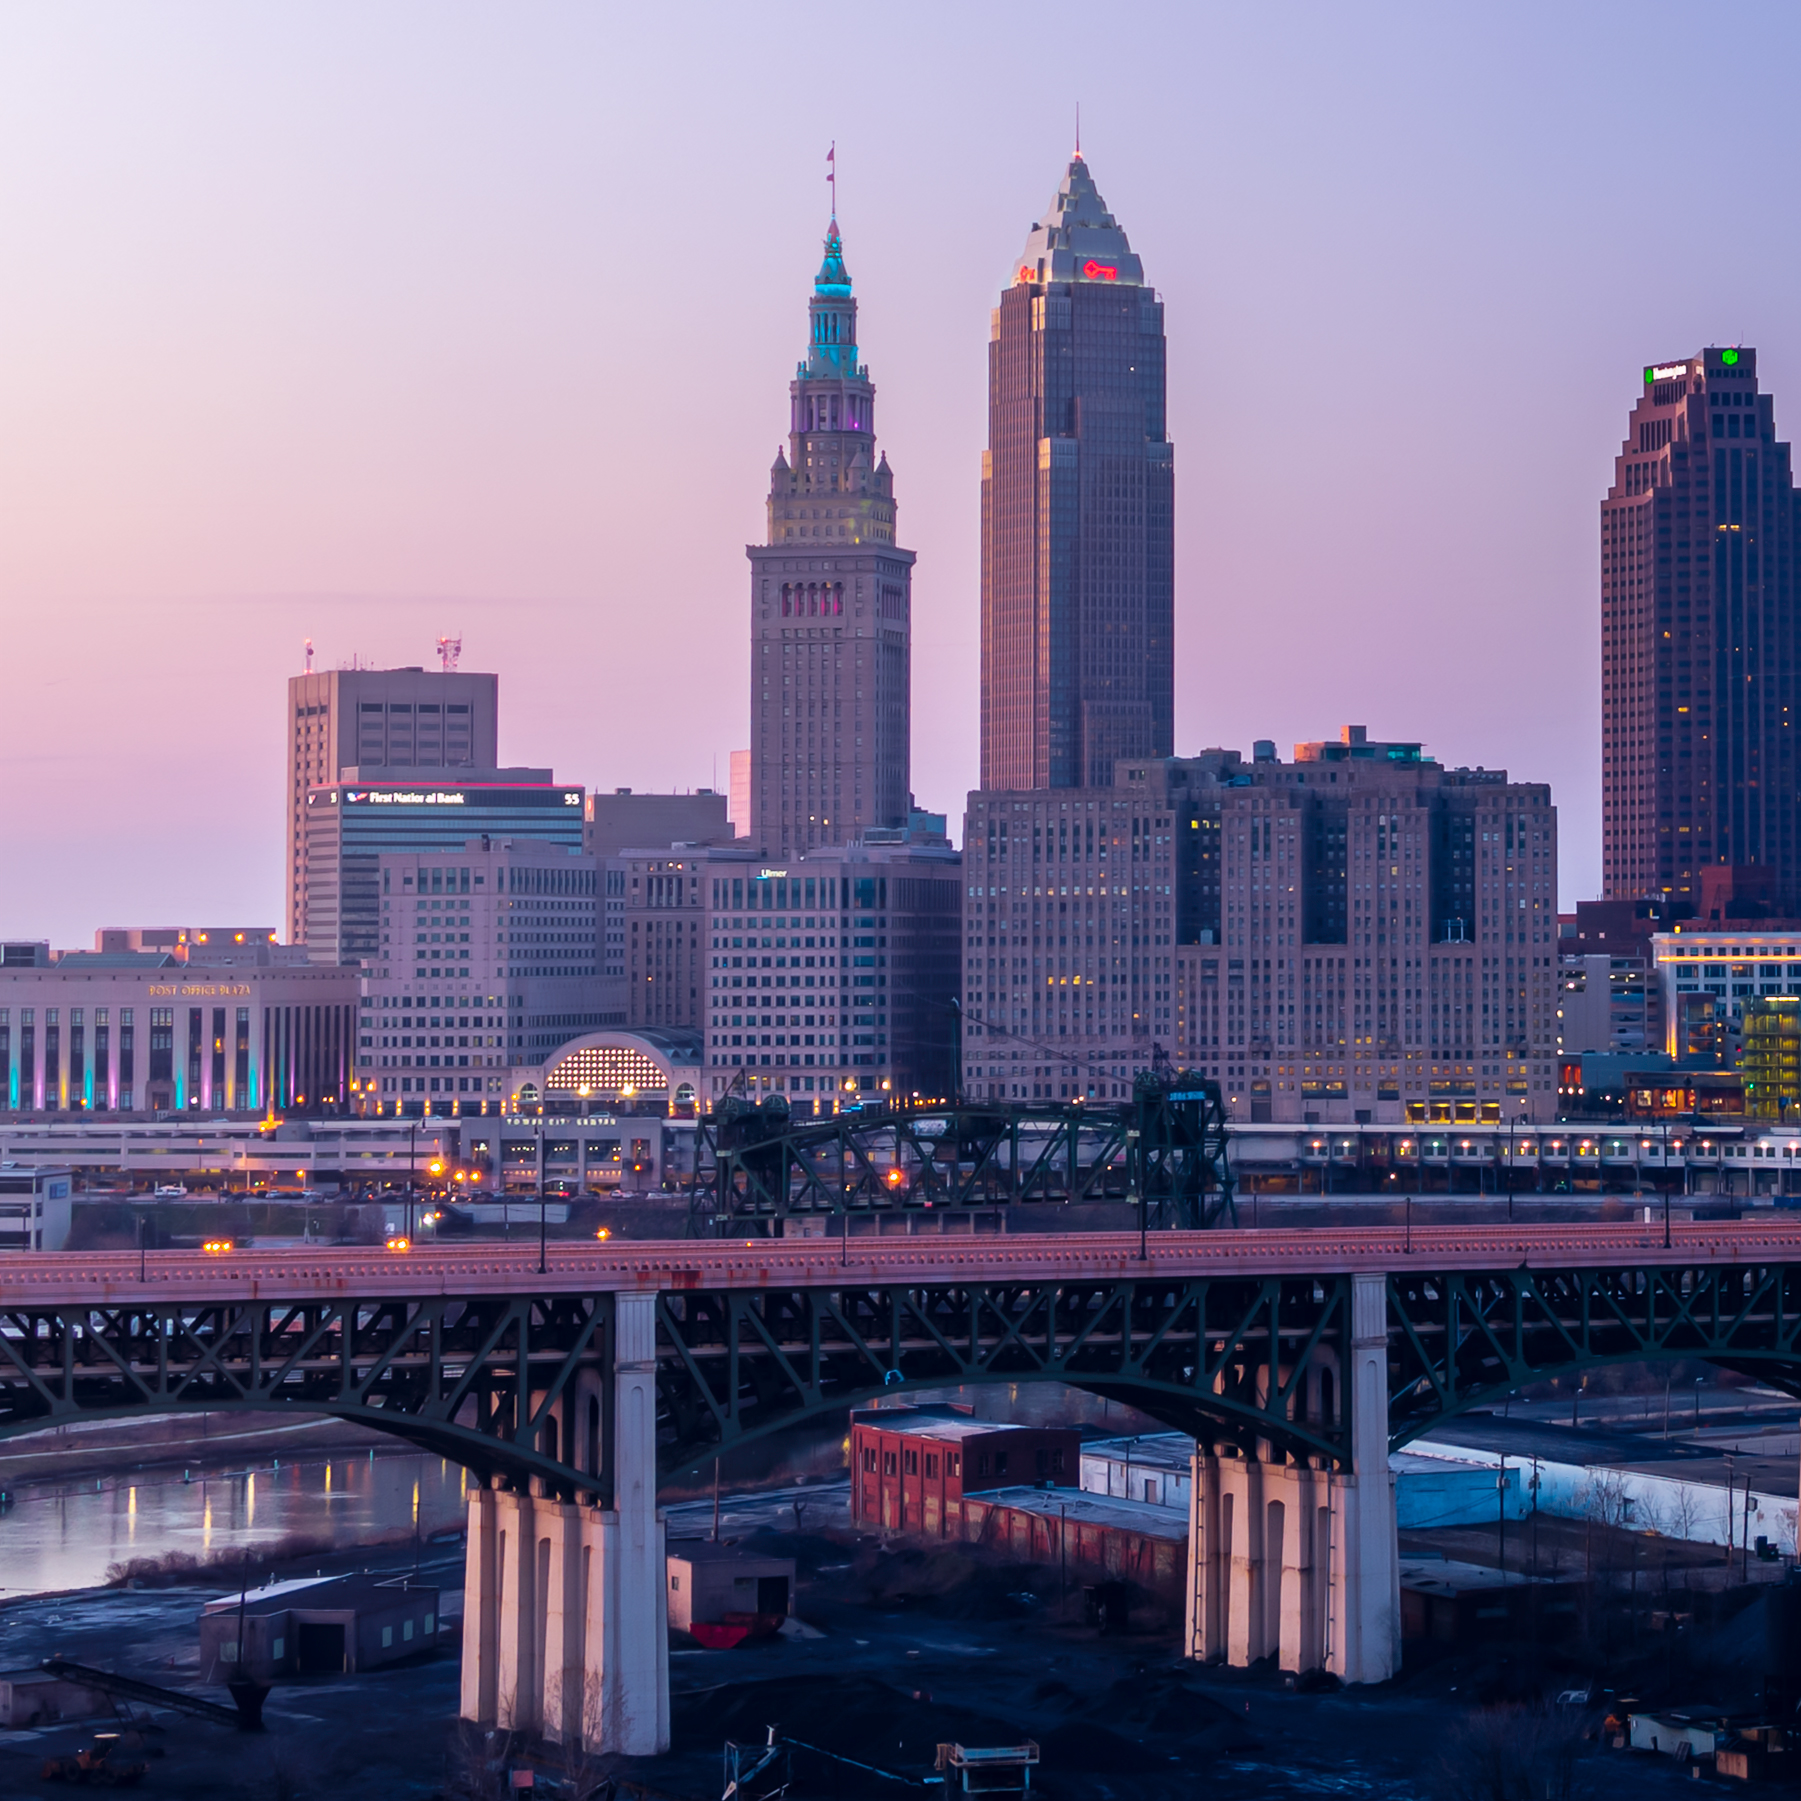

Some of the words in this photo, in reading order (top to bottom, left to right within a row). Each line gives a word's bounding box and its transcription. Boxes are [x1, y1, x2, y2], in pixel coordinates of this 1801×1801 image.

[369, 792, 392, 803] First
[437, 792, 464, 804] Bank
[149, 985, 177, 996] POST
[181, 985, 215, 996] OFFICE
[219, 984, 251, 996] PLAZA
